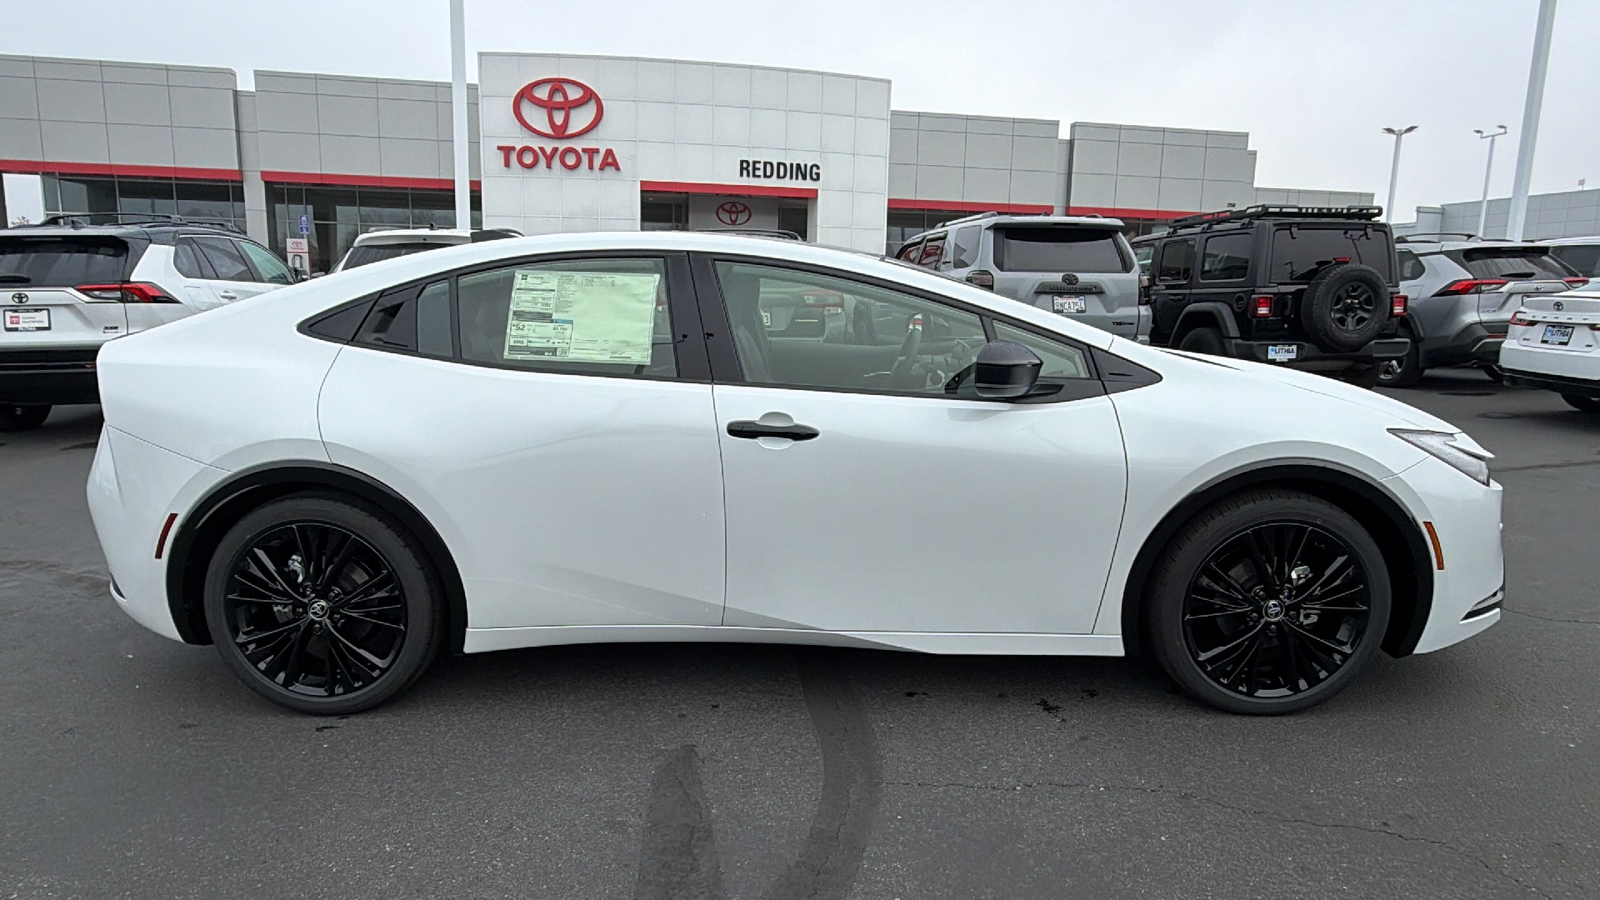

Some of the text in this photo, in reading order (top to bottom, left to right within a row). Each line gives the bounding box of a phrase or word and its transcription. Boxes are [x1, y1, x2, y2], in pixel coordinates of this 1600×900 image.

[497, 145, 621, 171] TOYOTA
[739, 159, 821, 182] REDDING
[1551, 329, 1570, 337] LITHIA
